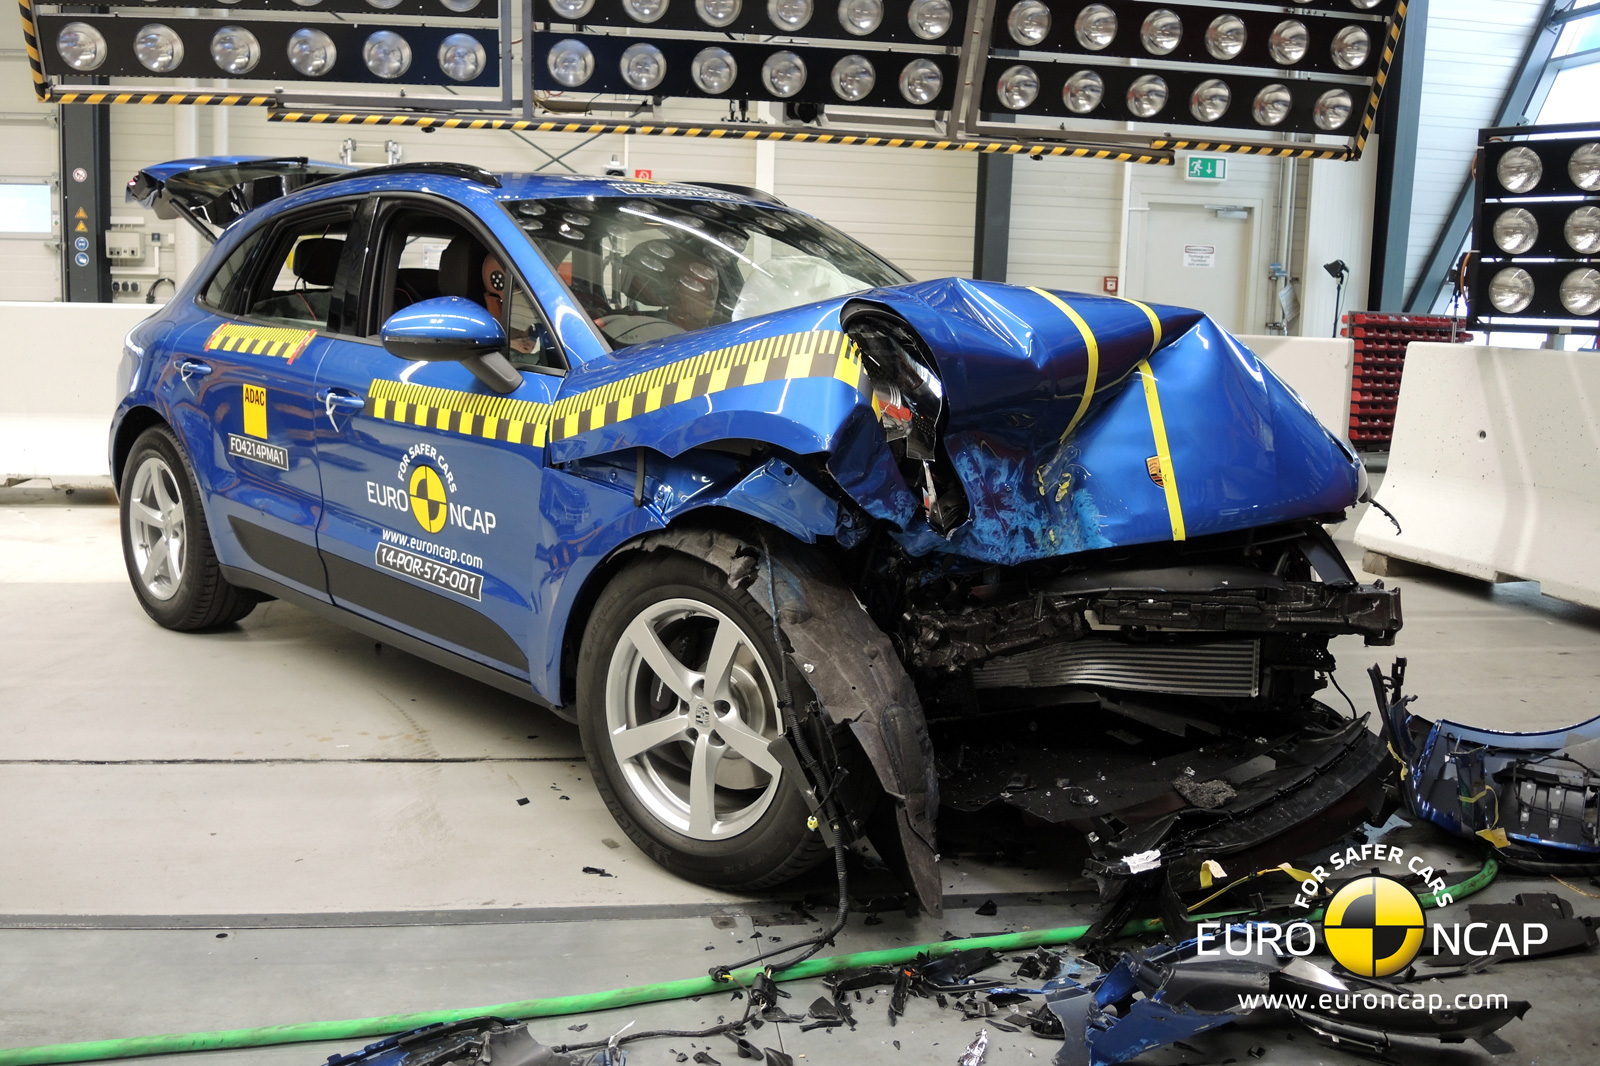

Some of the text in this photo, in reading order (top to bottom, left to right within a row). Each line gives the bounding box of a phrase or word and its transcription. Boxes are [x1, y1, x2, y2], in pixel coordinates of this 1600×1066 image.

[245, 387, 265, 406] ADAC
[398, 443, 457, 493] FOR SAFER CARS
[366, 481, 497, 535] EURO NCAP
[382, 529, 483, 569] www.euroncap.com
